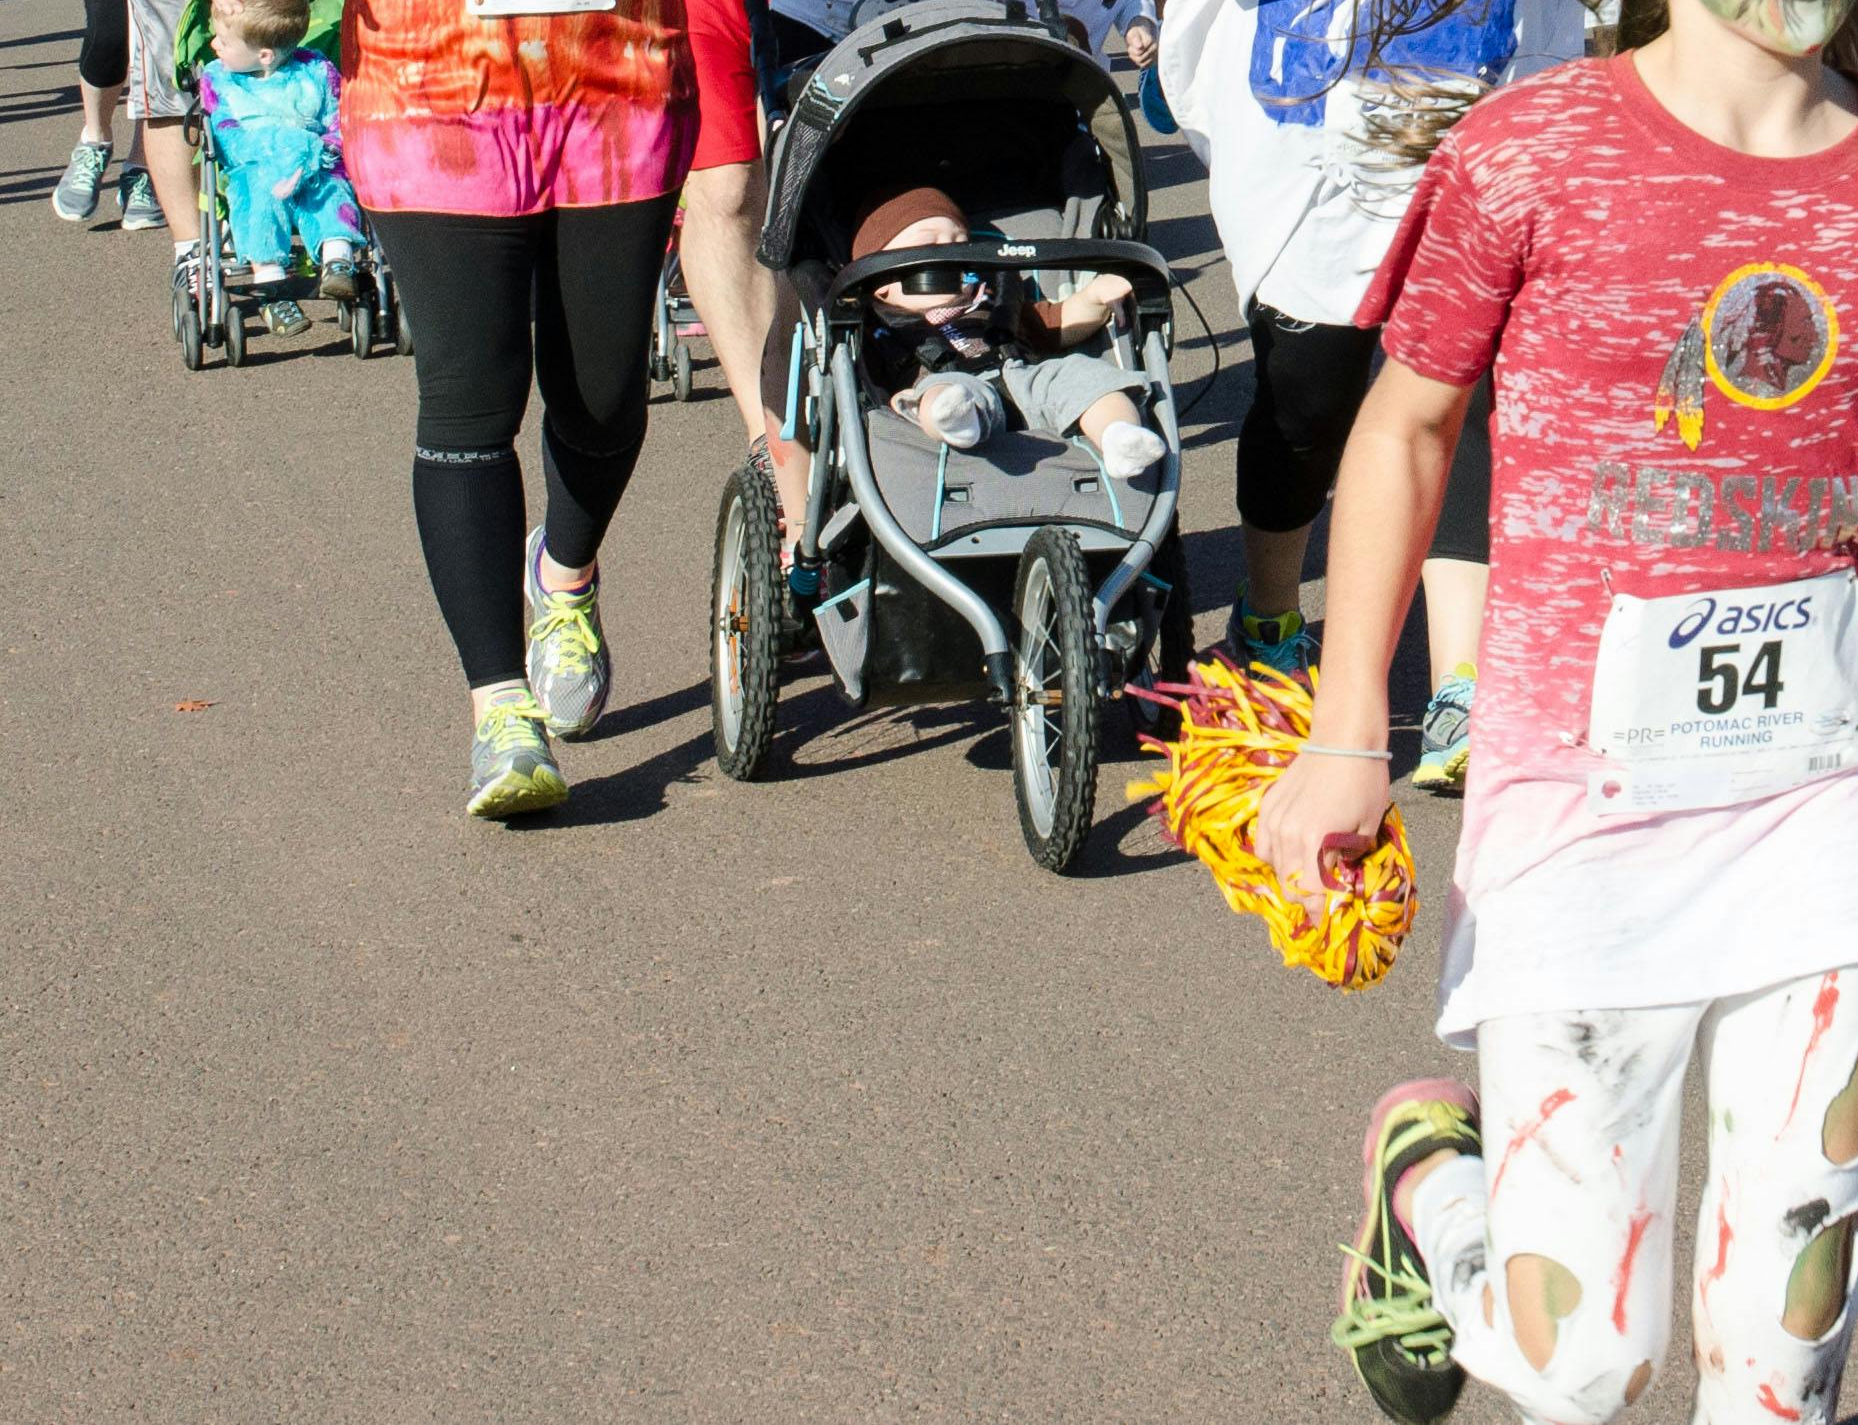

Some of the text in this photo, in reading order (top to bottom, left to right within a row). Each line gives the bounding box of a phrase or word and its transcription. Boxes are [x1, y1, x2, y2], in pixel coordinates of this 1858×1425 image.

[997, 243, 1037, 258] Jeep
[1716, 596, 1812, 636] asics
[1696, 640, 1784, 715] 54
[1671, 717, 1752, 735] POTOMAC
[1757, 711, 1804, 729] RIVER
[1699, 730, 1773, 749] RUNNING
